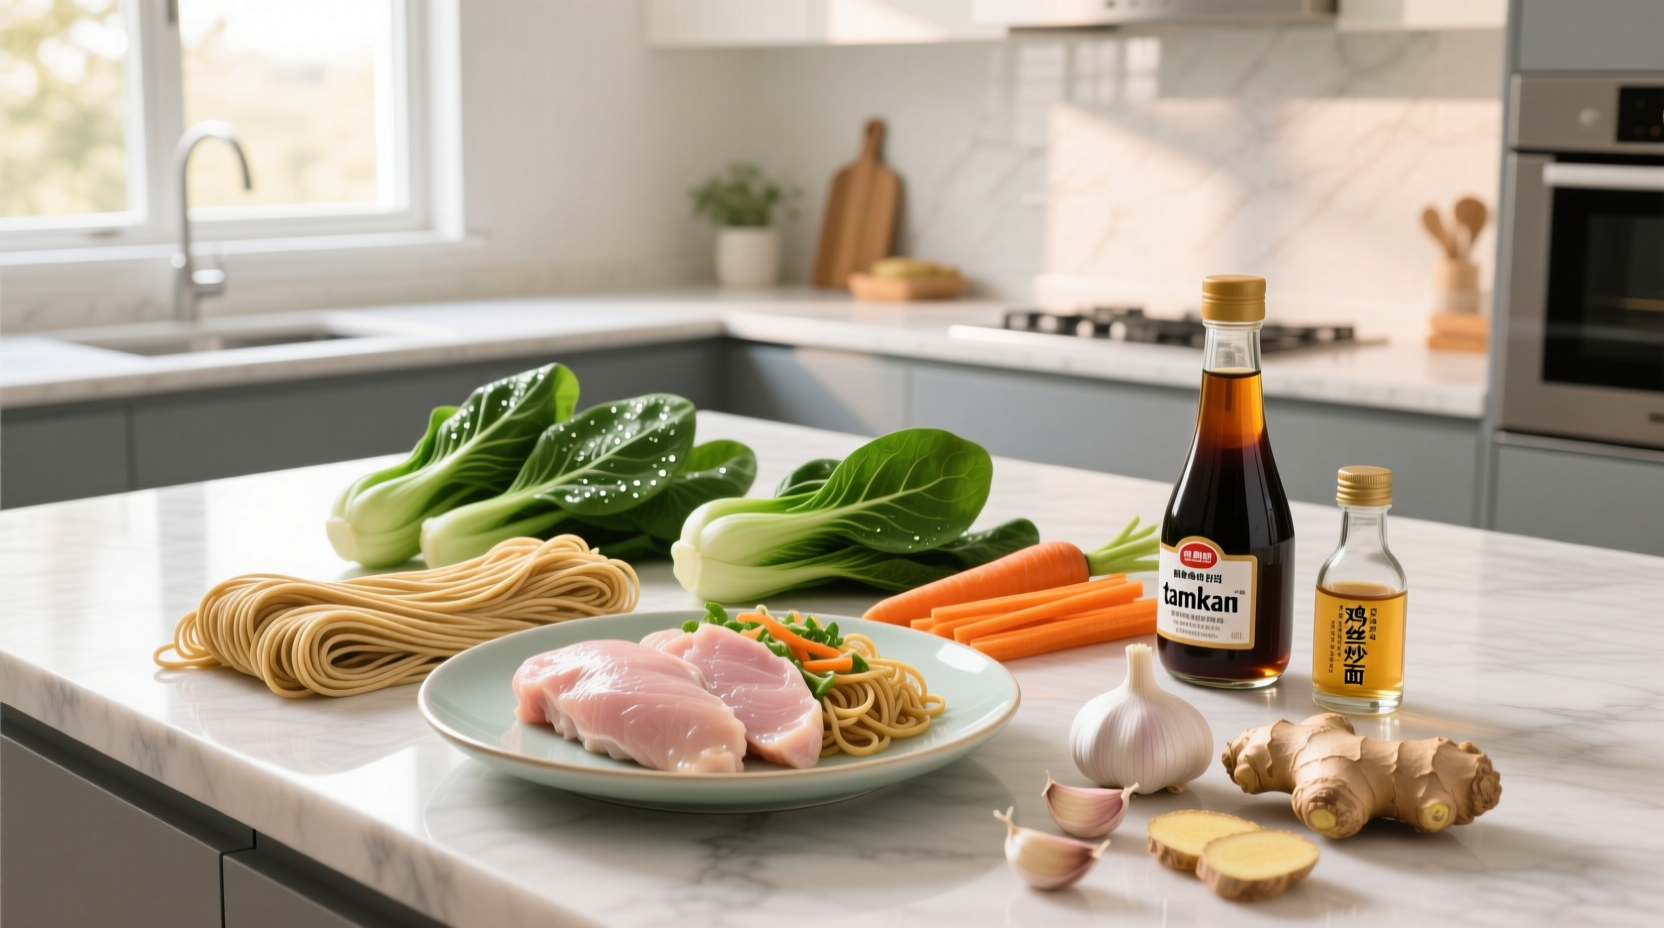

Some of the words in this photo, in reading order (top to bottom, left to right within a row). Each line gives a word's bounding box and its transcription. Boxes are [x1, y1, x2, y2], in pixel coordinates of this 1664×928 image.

[1163, 581, 1238, 613] tamkan
[1343, 605, 1368, 686] 鸡丝炒面
